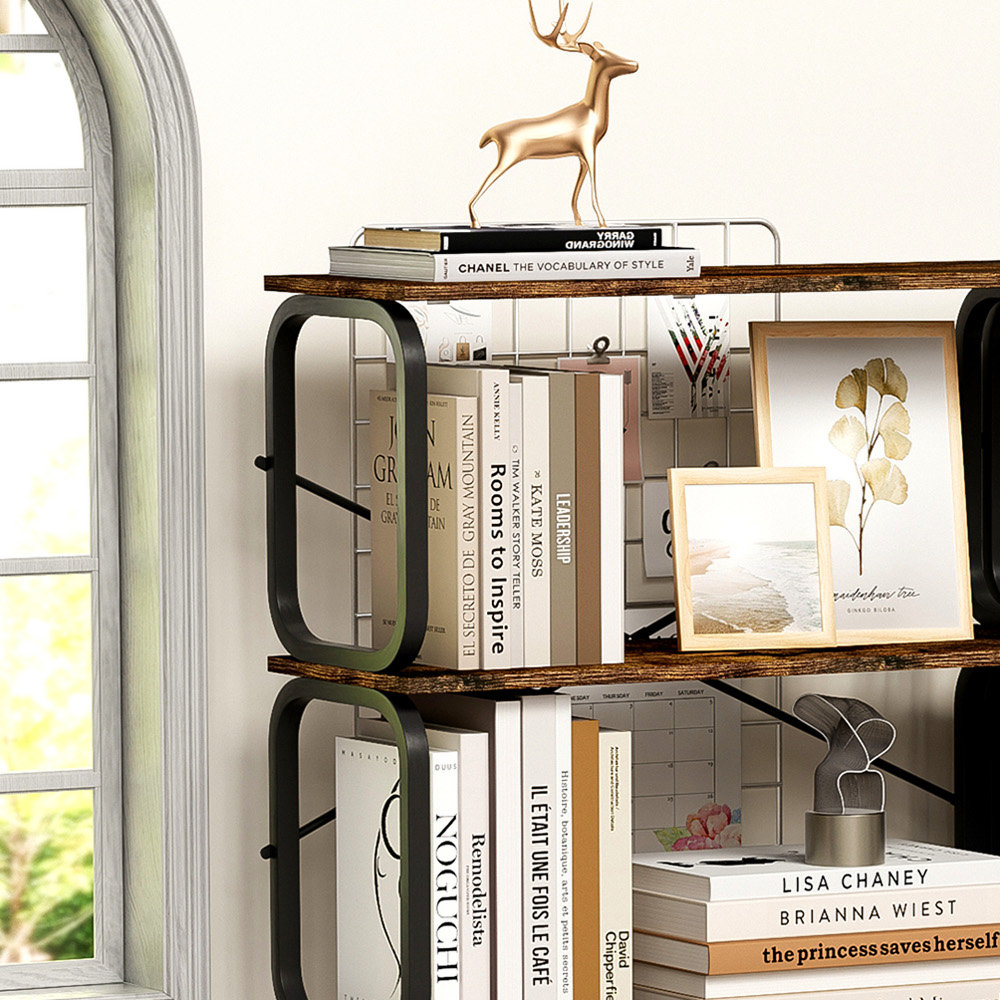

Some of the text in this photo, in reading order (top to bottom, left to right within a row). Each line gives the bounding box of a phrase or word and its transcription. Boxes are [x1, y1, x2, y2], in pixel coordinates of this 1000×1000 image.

[458, 260, 664, 273] CHANEL THE VOCABULARY OF STYLE
[686, 255, 695, 273] Yale
[462, 414, 475, 656] EL SECRETO DE GRAY MOUNTAIN
[512, 459, 521, 610] TIM WALKER STORY TELLER
[531, 484, 543, 578] KATE MOSS
[555, 493, 571, 564] LEADERSHIP
[487, 464, 508, 654] Rooms to Inspire
[560, 770, 569, 818] Histoire,
[560, 820, 569, 877] botanique,
[435, 814, 459, 983] NOGUCHI
[471, 833, 487, 947] Remodelista
[783, 868, 929, 893] LISA CHANEY
[560, 919, 569, 951] petits
[561, 905, 569, 917] et
[780, 900, 957, 926] BRIANNA WIEST
[618, 930, 630, 968] David
